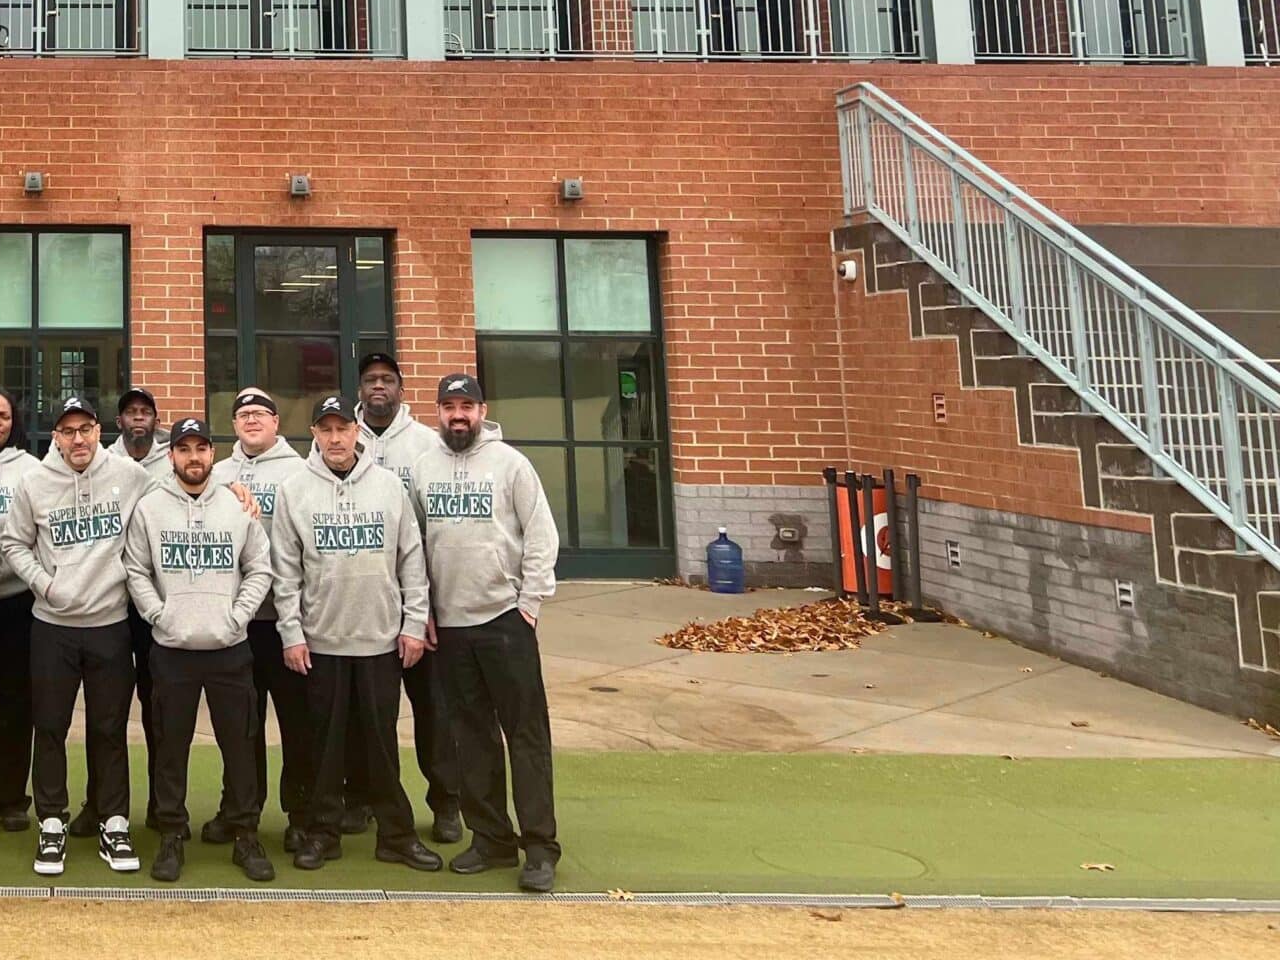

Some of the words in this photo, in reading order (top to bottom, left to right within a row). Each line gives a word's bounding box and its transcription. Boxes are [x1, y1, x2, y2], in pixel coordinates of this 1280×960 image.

[427, 482, 452, 493] SUPER
[479, 482, 493, 493] LIX
[49, 507, 76, 522] SUPER
[107, 500, 120, 512] LIX
[427, 494, 492, 517] EAGLES
[313, 513, 341, 524] SUPER
[371, 511, 384, 523] LIX
[50, 515, 123, 545] EAGLES
[160, 531, 189, 543] SUPER
[219, 531, 232, 543] LIX
[314, 525, 384, 549] EAGLES
[161, 545, 233, 568] EAGLES
